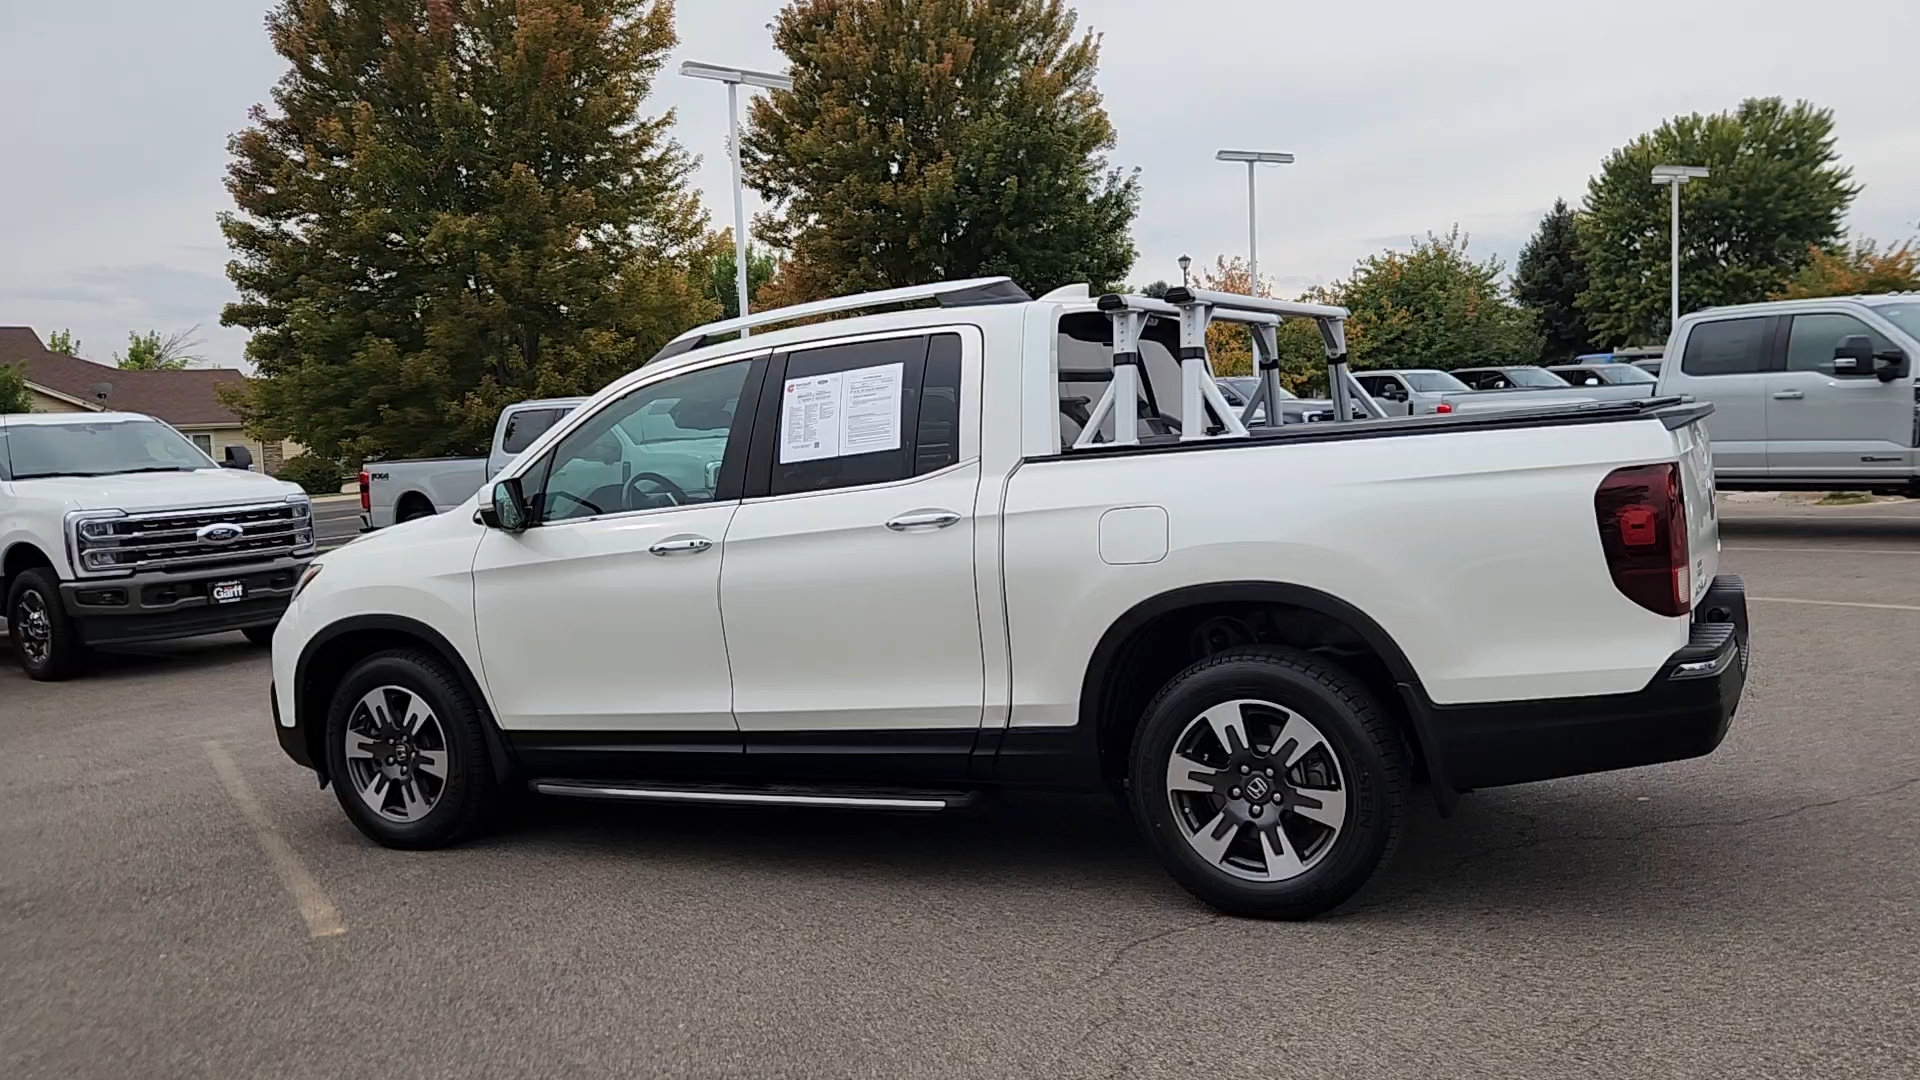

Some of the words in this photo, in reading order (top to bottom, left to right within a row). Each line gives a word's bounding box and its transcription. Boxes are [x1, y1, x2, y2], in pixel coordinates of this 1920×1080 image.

[371, 472, 390, 481] FX4
[211, 528, 233, 540] Ford
[213, 584, 243, 599] Garff
